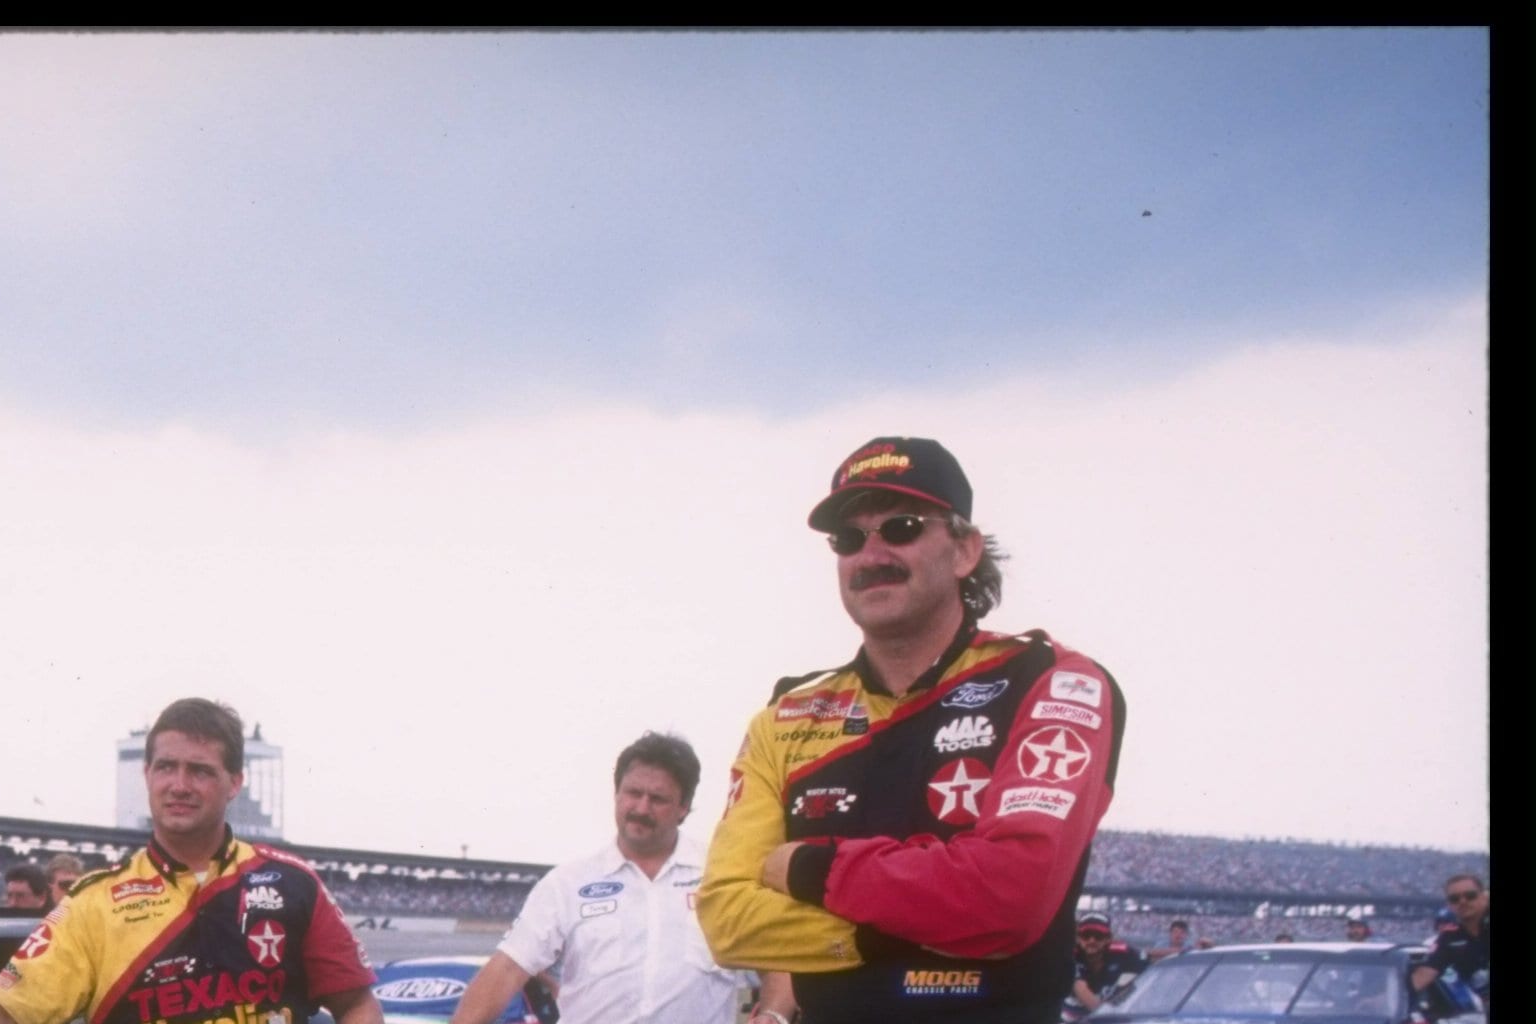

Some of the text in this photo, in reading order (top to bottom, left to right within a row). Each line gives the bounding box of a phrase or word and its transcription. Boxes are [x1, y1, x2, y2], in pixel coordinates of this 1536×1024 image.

[952, 686, 996, 703] Ford
[1041, 704, 1094, 722] SIMPSON
[934, 716, 993, 744] MAC
[934, 736, 993, 753] TOOLS
[903, 970, 982, 987] MOOG
[128, 969, 286, 1022] TEXACO
